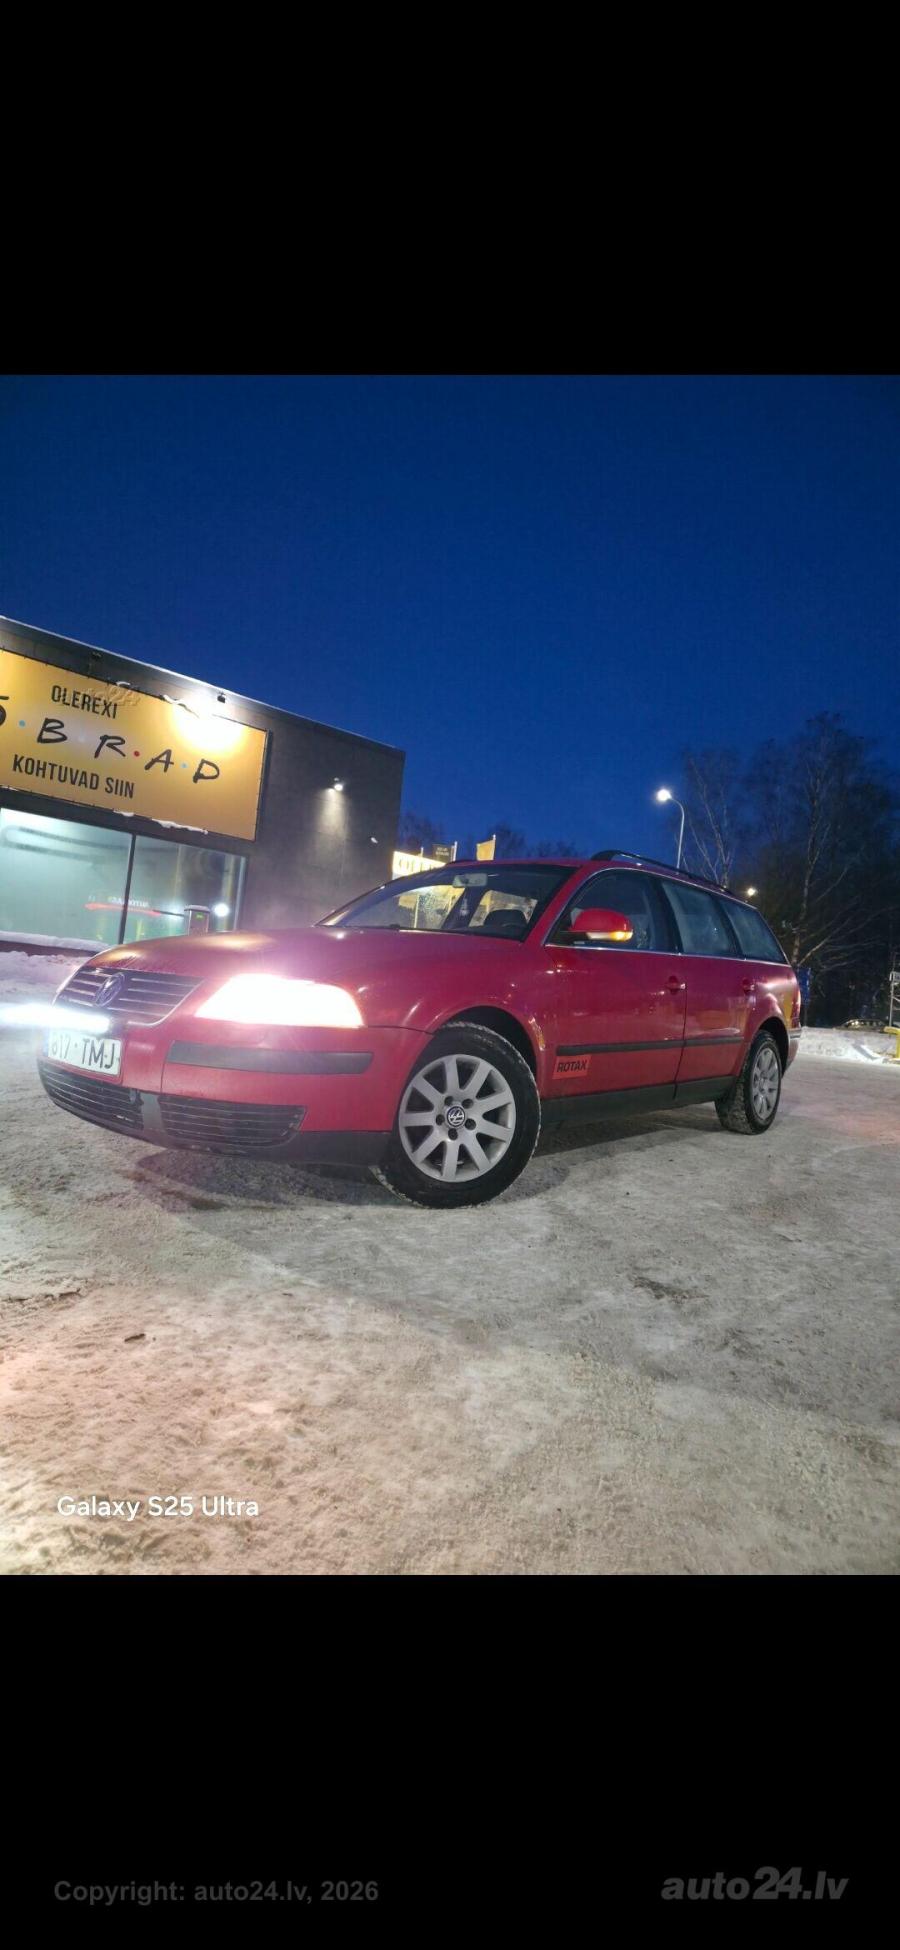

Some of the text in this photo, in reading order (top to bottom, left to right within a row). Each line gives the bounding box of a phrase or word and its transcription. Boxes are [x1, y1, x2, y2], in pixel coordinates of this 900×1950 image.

[51, 685, 118, 719] OLEREXI
[12, 754, 134, 799] KOHTUVAD SIIN
[82, 1038, 115, 1069] TMJ
[557, 1061, 588, 1073] ROTAX
